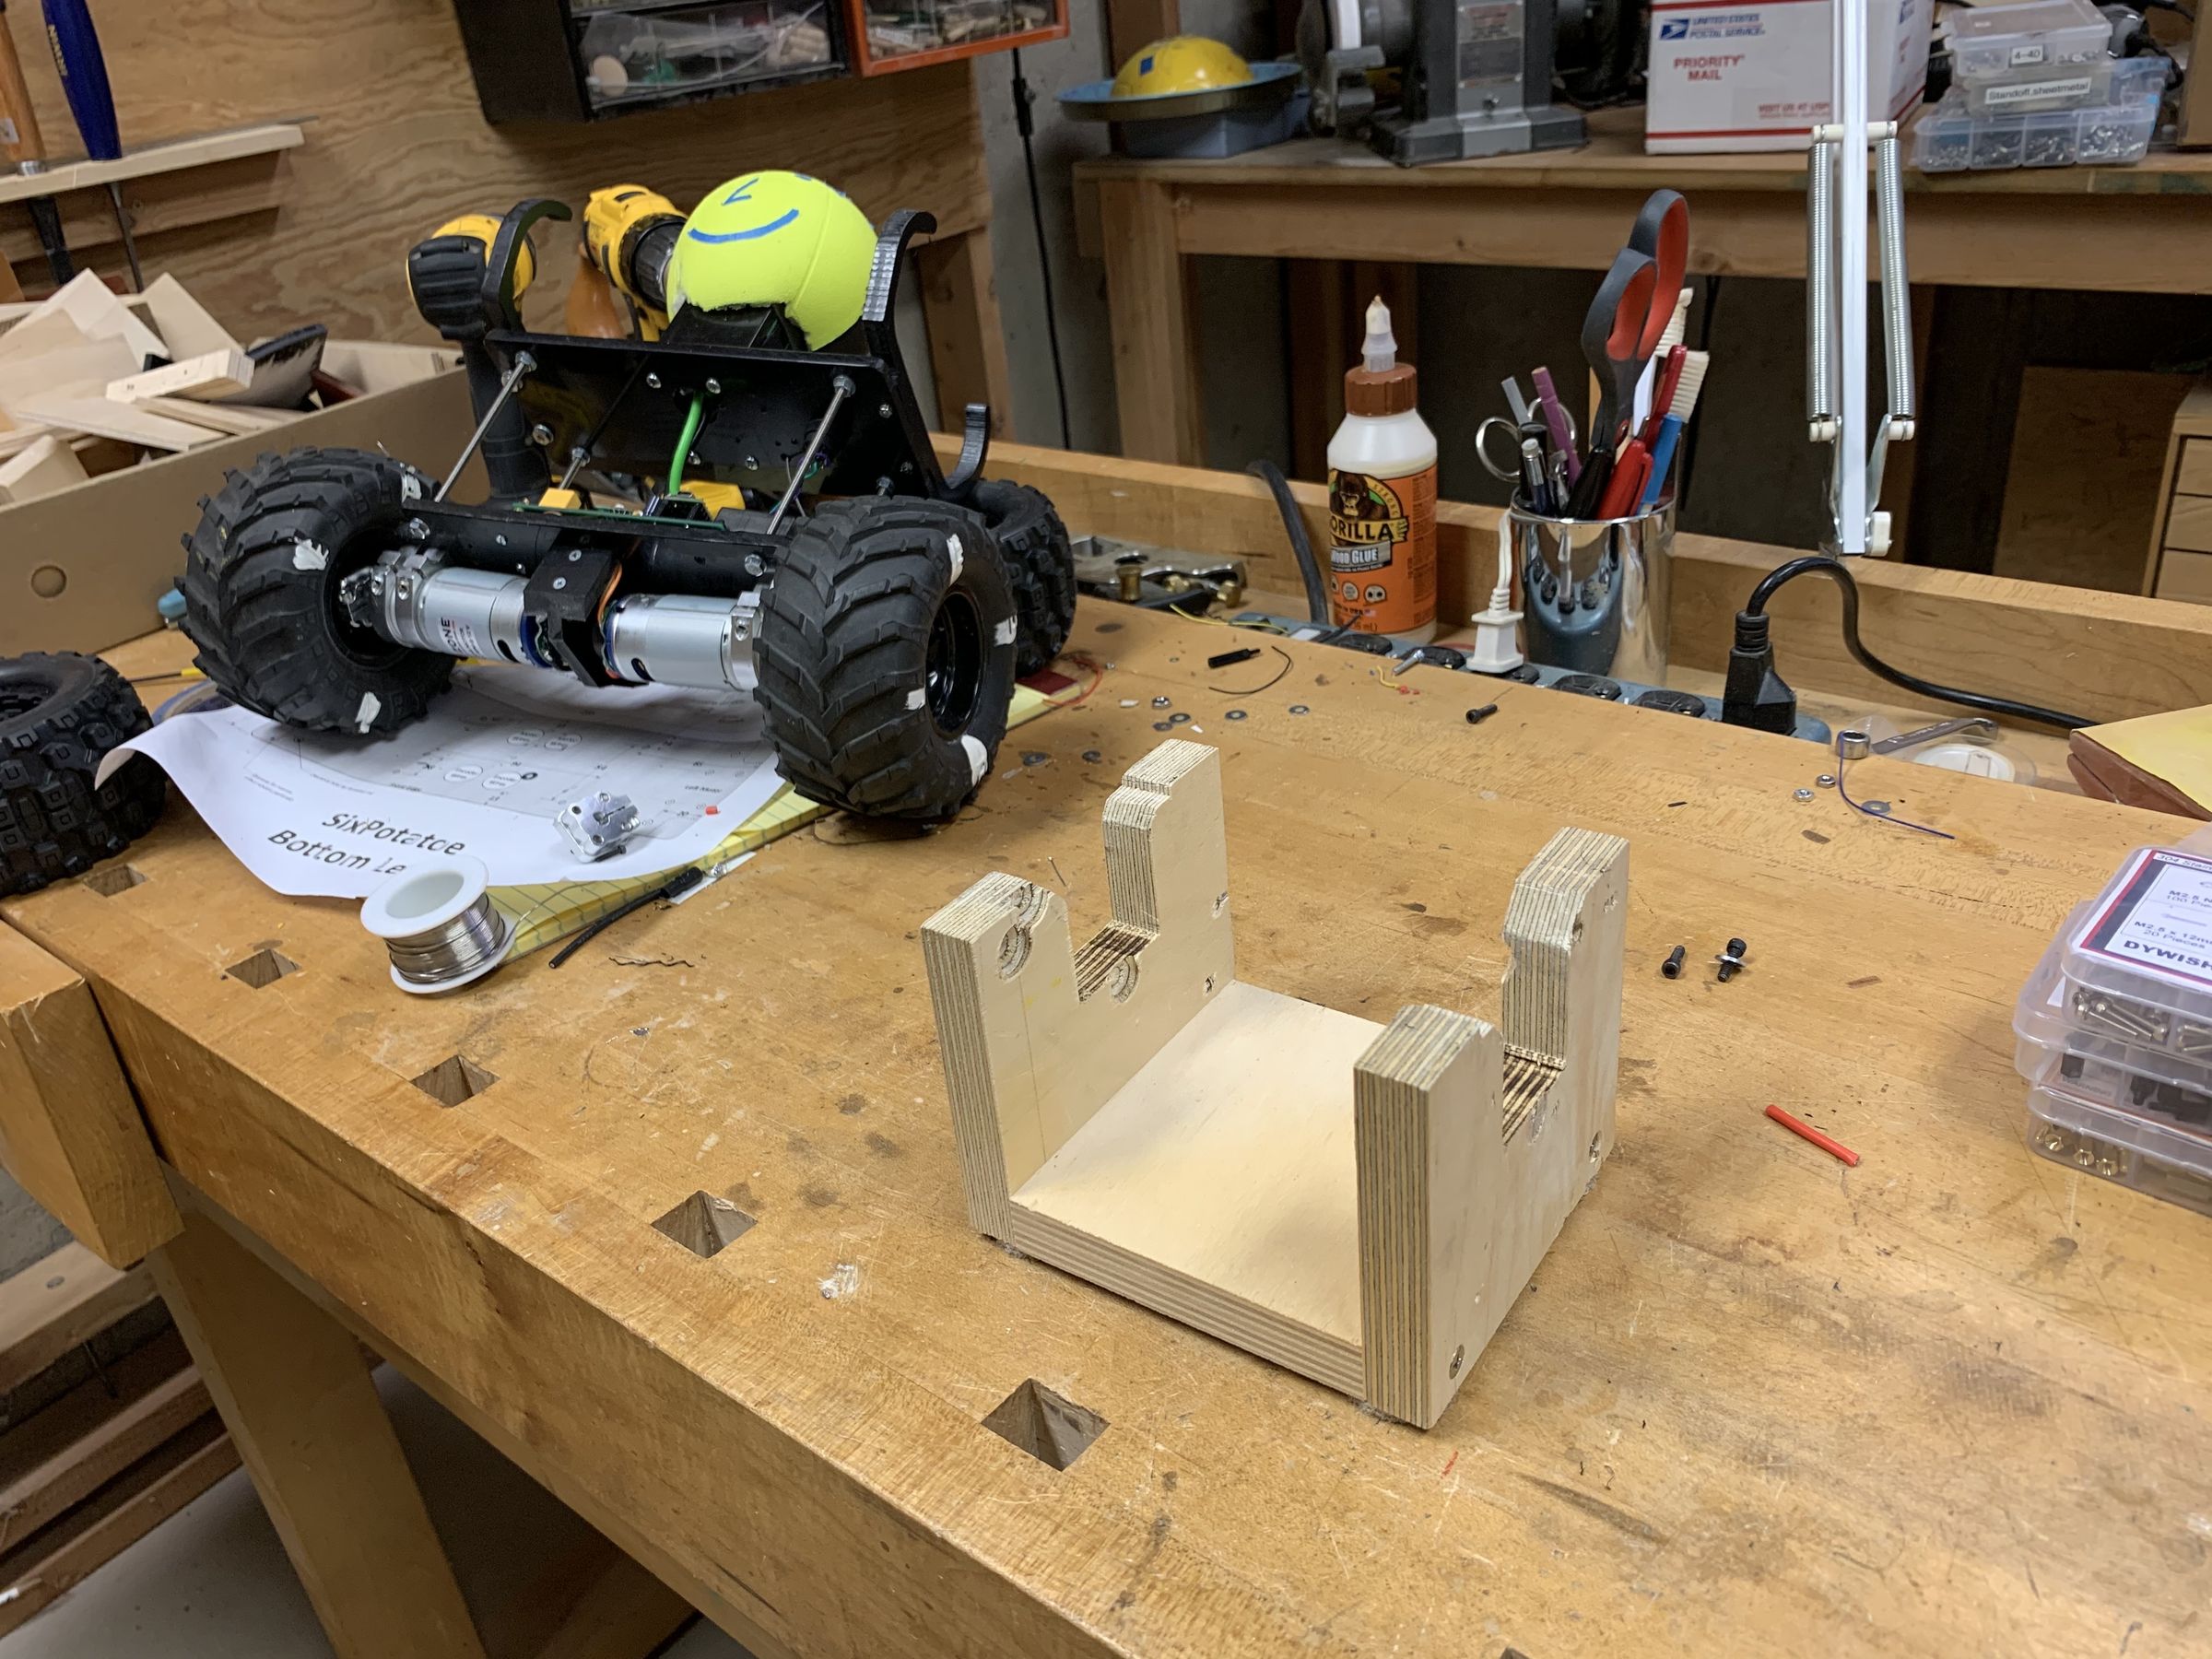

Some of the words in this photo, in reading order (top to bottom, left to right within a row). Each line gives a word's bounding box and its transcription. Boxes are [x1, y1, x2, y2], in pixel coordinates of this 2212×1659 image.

[1673, 55, 1741, 69] PRIORITY
[1687, 70, 1722, 82] MAIL
[1330, 515, 1394, 541] ORILLA
[1351, 548, 1379, 564] GLUE
[267, 830, 372, 870] Bottom
[2143, 929, 2159, 937] 20
[2163, 934, 2206, 949] Pieces
